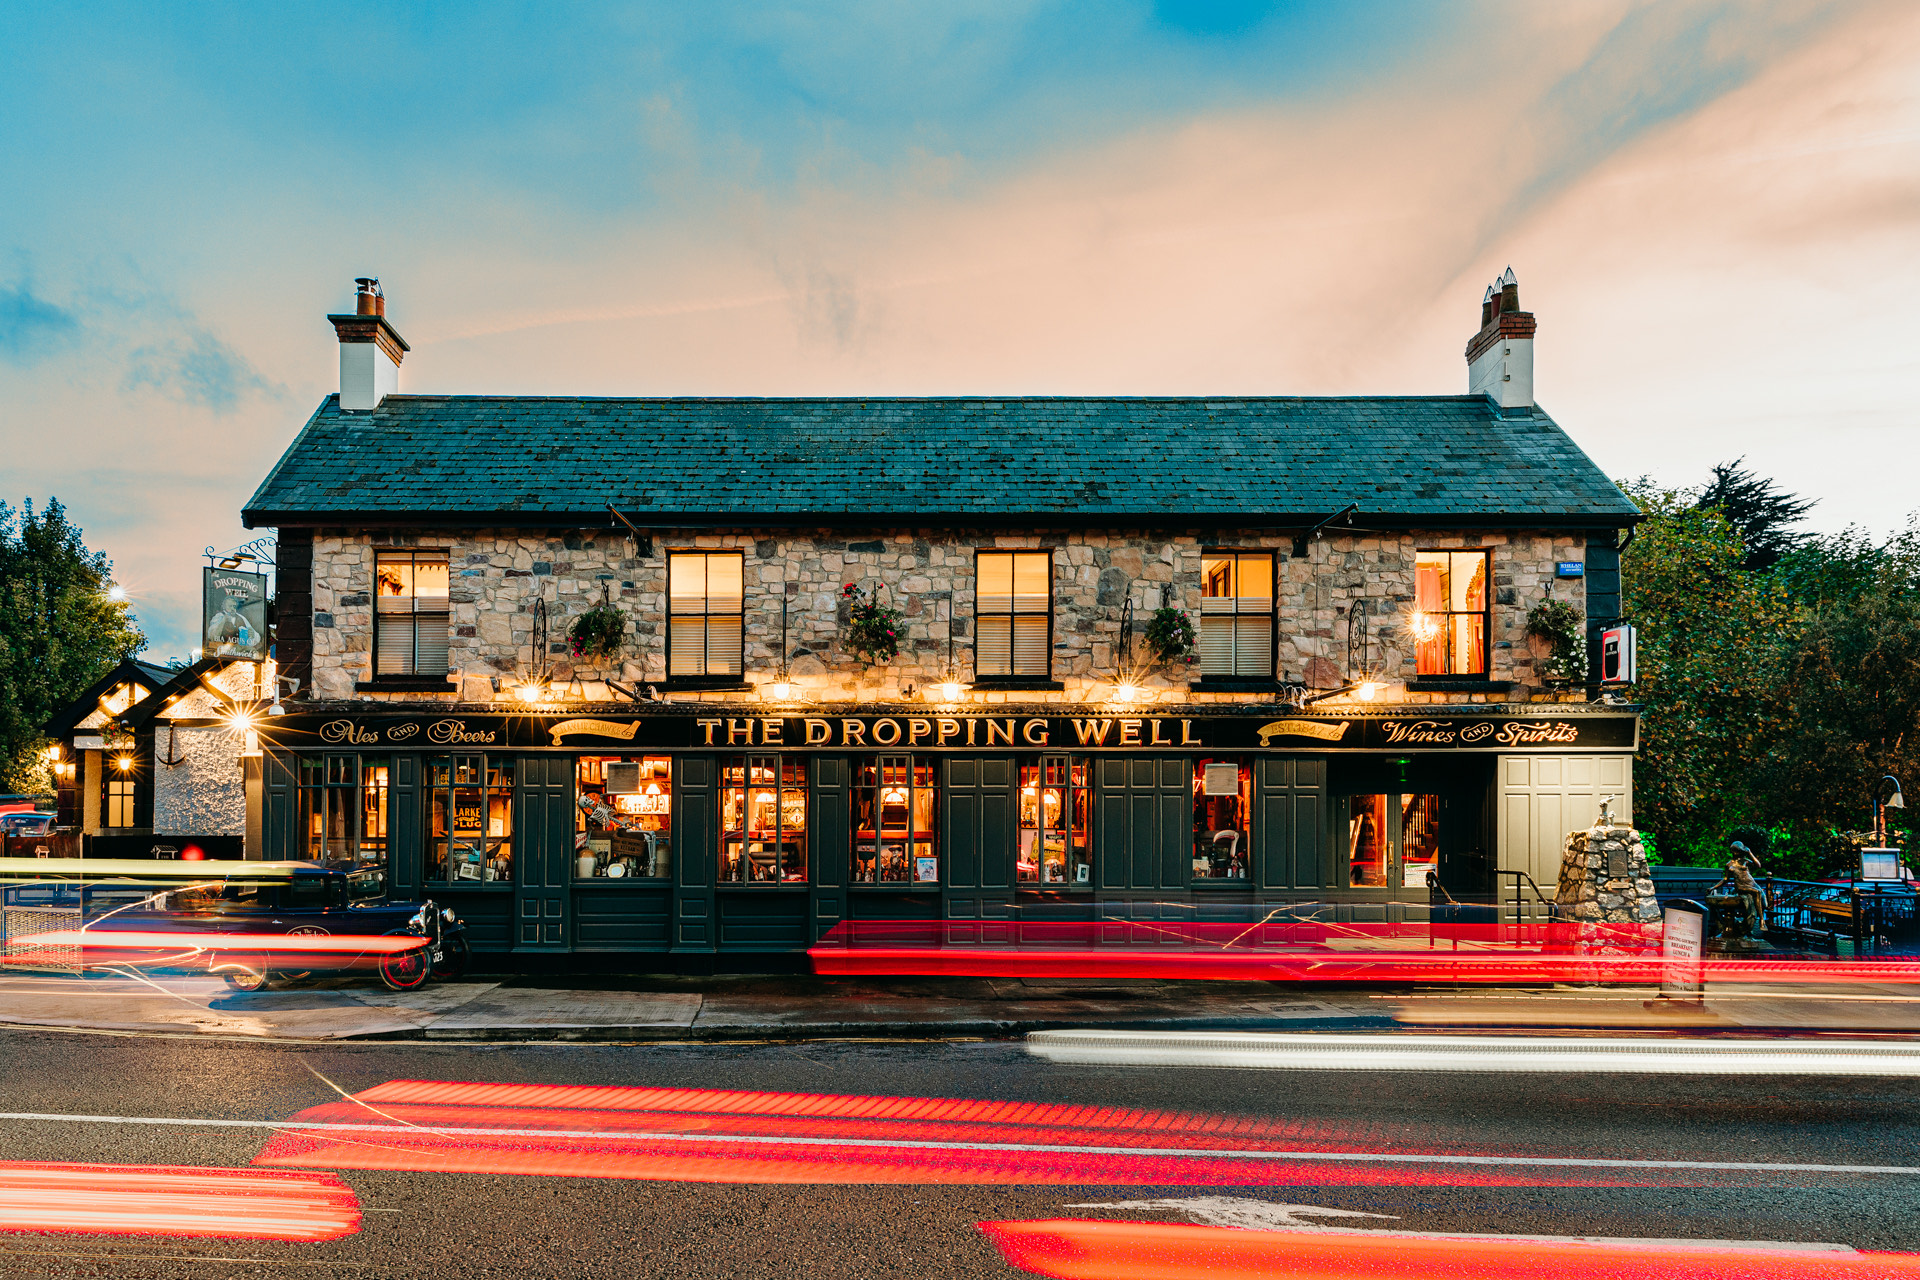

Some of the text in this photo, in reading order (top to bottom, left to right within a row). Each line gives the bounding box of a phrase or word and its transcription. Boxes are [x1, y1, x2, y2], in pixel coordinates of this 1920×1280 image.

[213, 576, 259, 593] DROPPING
[224, 587, 249, 598] WELL
[319, 718, 496, 745] Ales AND Beers
[696, 718, 1202, 747] THE DROPPING WELL
[1382, 720, 1579, 747] Wines AND Spirits
